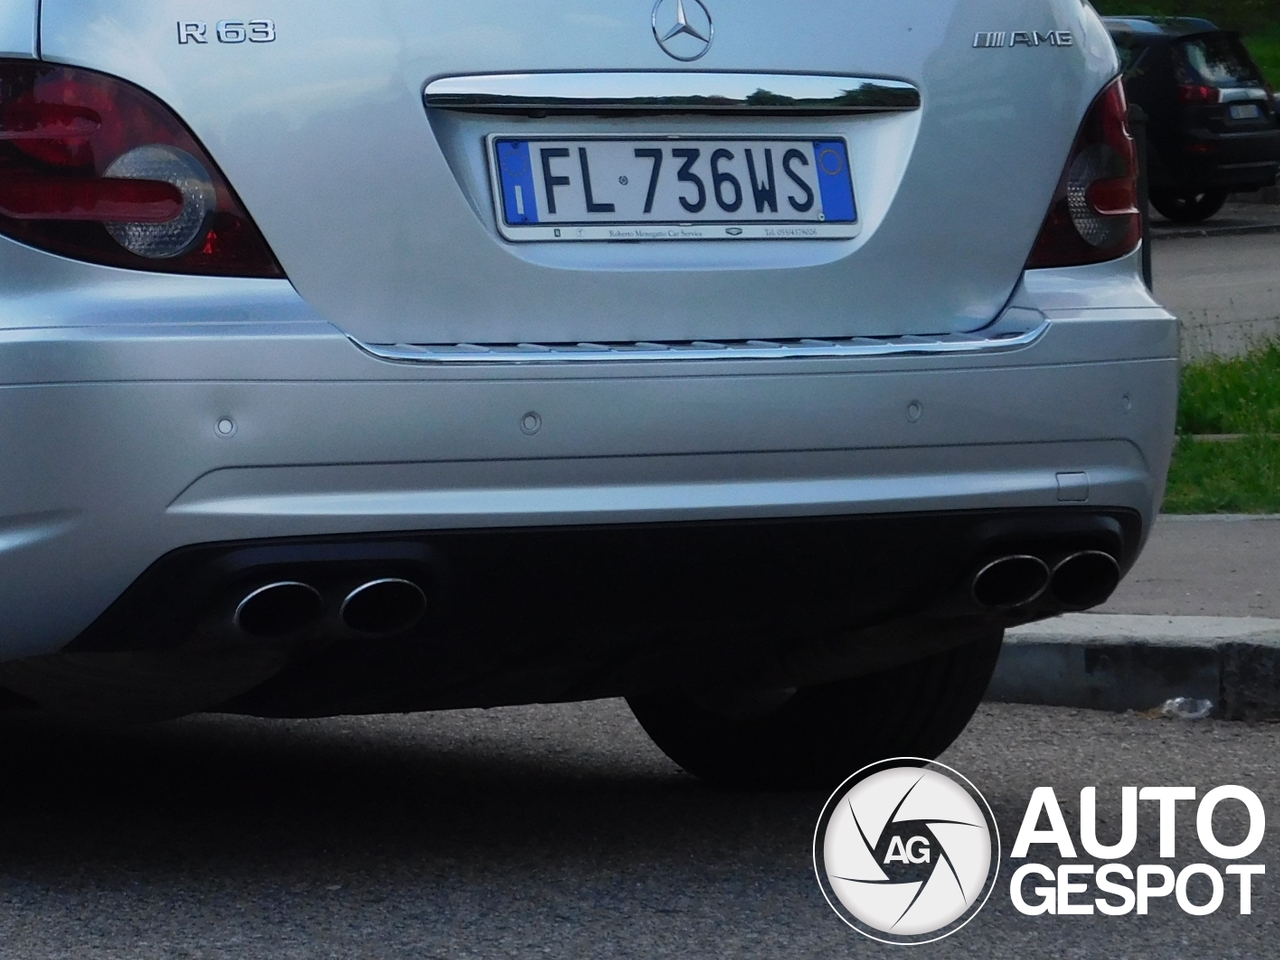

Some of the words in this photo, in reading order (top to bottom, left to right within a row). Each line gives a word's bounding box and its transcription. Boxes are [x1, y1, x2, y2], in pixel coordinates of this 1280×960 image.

[177, 20, 208, 44] R
[216, 19, 276, 43] 63
[540, 147, 616, 214] FL
[634, 148, 815, 214] 736WS
